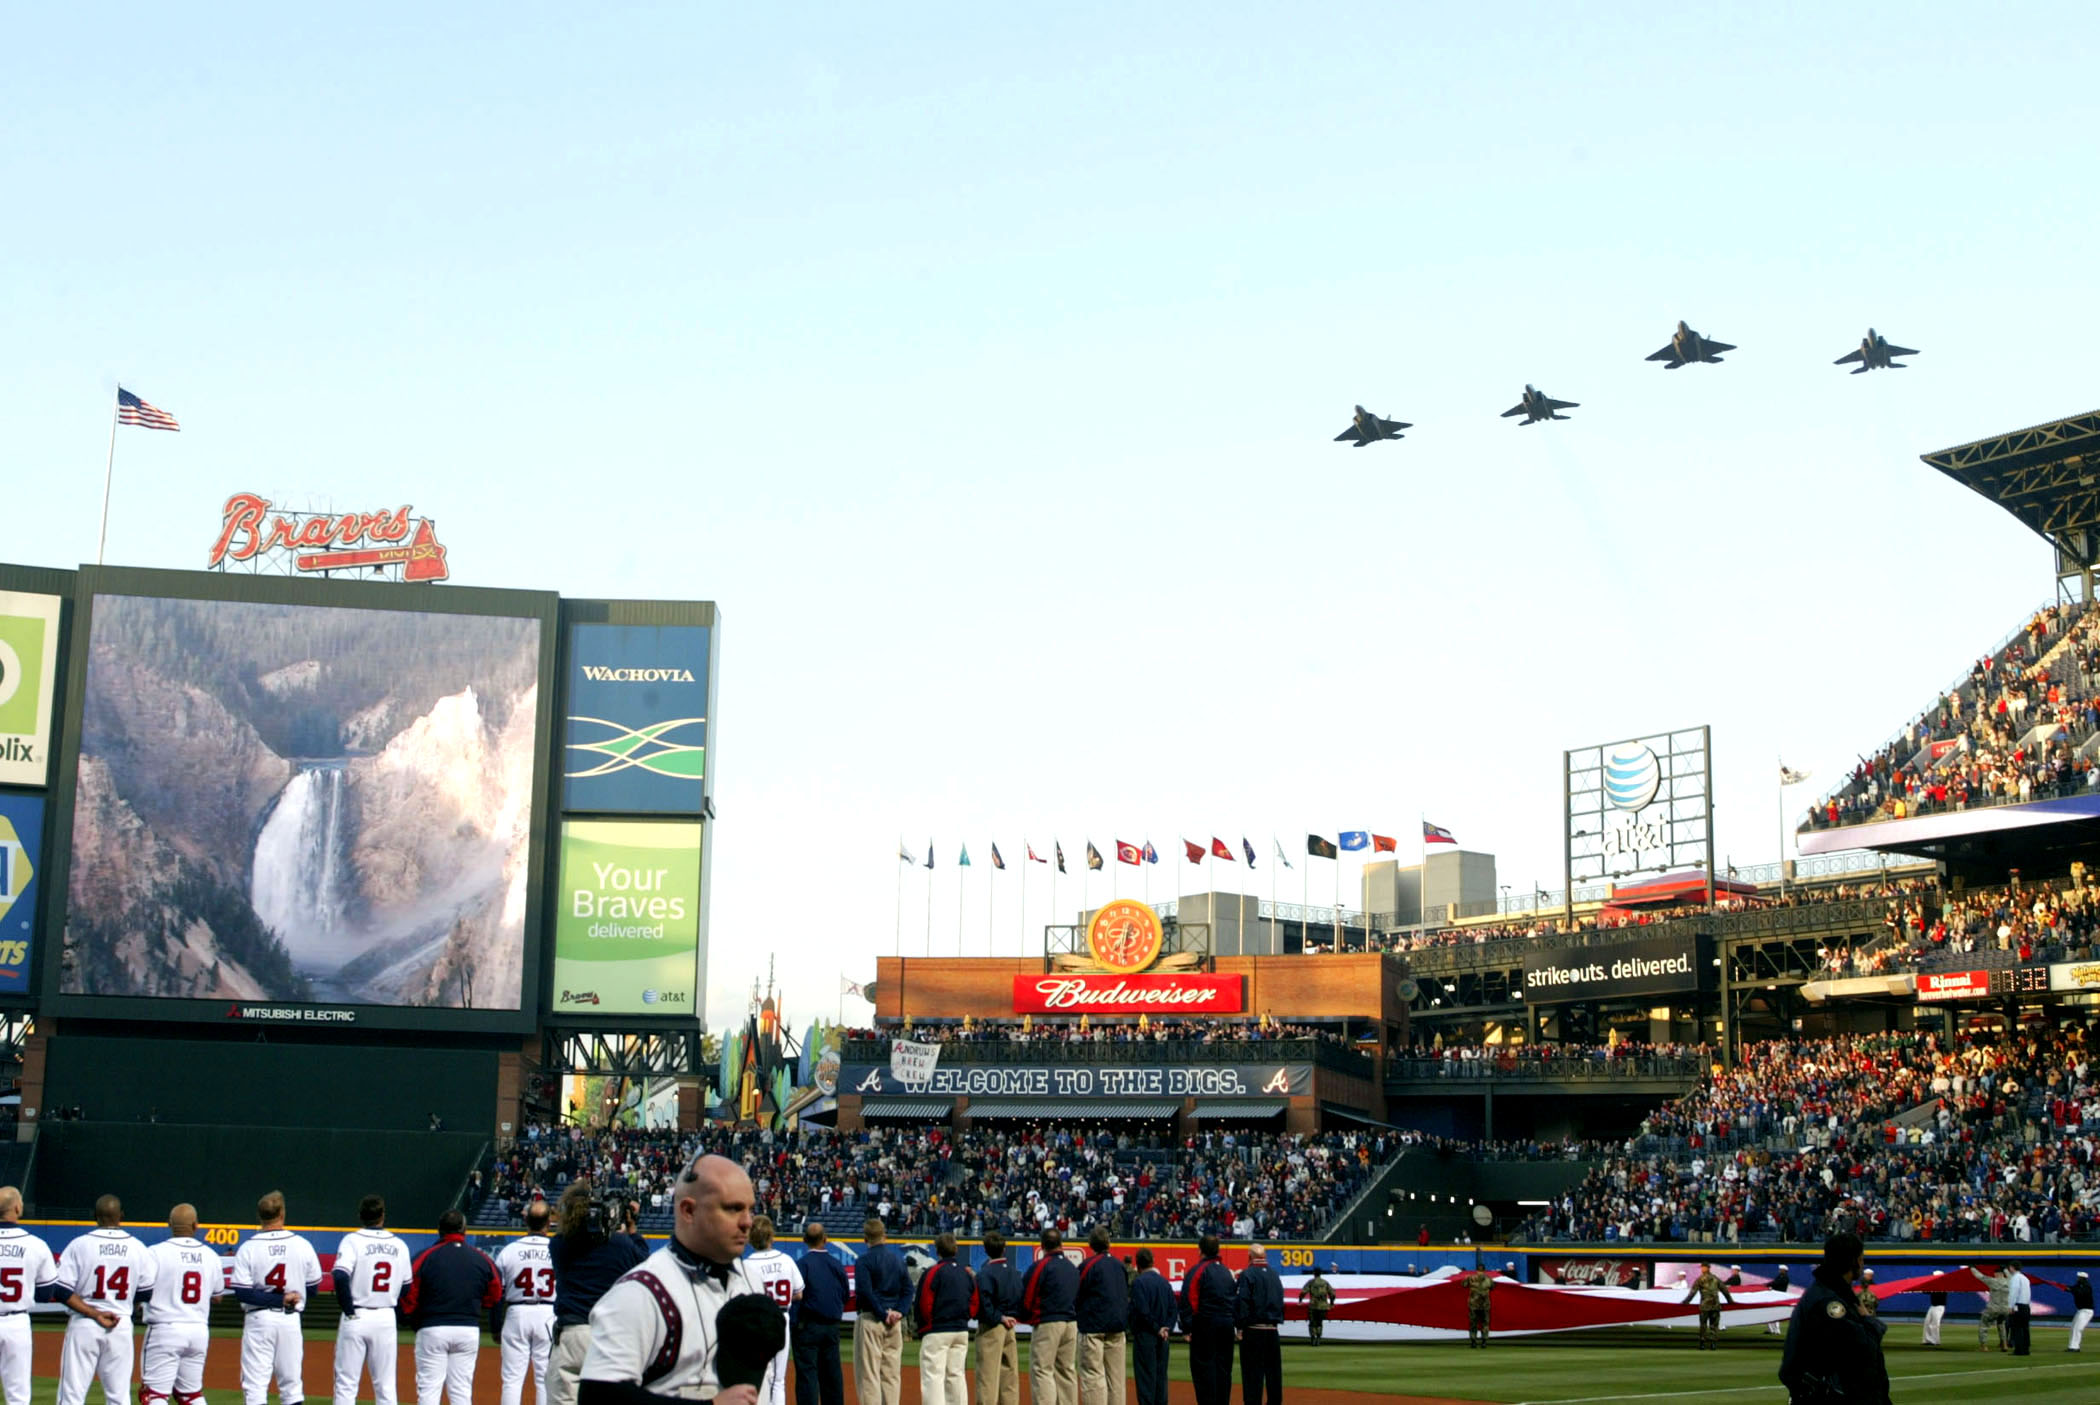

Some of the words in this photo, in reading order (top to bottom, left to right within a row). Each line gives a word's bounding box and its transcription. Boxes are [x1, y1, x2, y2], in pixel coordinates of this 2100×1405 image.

[208, 492, 413, 569] Braves
[581, 665, 696, 683] WACHOVIA
[1601, 813, 1669, 857] at&t
[593, 861, 668, 891] Your
[573, 889, 686, 921] Braves
[588, 922, 665, 939] delivered
[1527, 963, 1609, 987] strikeouts.
[1611, 952, 1693, 979] delivered.
[1930, 972, 1972, 989] Rinnai
[660, 992, 685, 1002] at&t
[1036, 979, 1217, 1008] Budweiser
[243, 1008, 302, 1020] MITSUBISHI
[304, 1010, 355, 1022] ELECTRIC
[1055, 1069, 1093, 1094] TO
[1100, 1069, 1162, 1094] THE
[1169, 1069, 1246, 1094] BIGS.
[204, 1229, 239, 1246] 400
[364, 1243, 399, 1257] JOHNSON
[1281, 1250, 1314, 1267] 390
[91, 1264, 130, 1301] 14
[180, 1270, 202, 1305] 8
[264, 1262, 287, 1294] 4
[371, 1261, 393, 1293] 2
[514, 1266, 556, 1298] 43
[763, 1278, 792, 1307] 59
